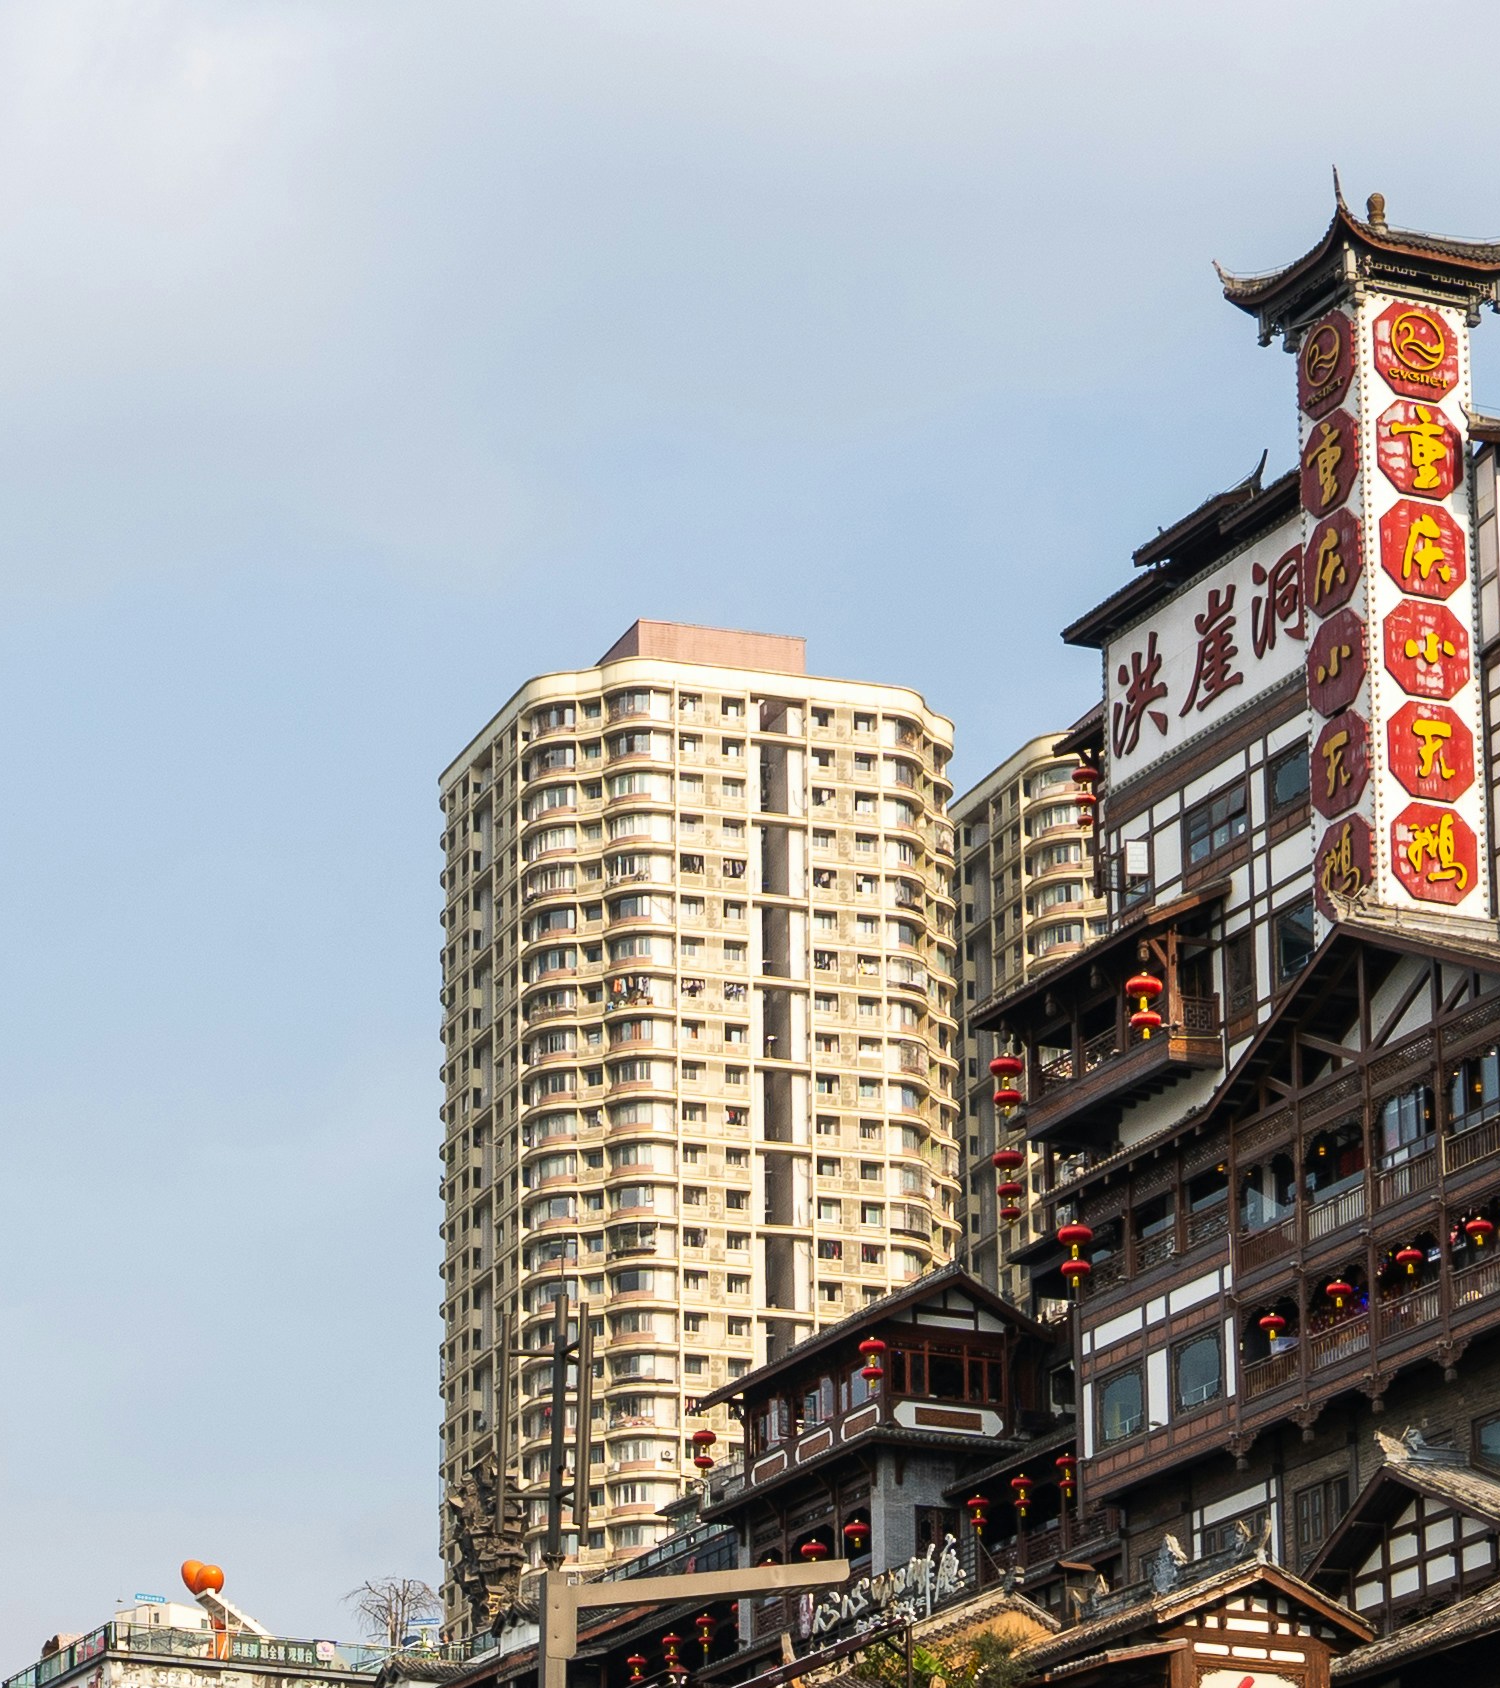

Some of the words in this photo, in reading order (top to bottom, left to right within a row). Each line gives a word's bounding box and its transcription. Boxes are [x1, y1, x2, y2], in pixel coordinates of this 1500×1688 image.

[1113, 543, 1306, 759] 洪崖洞
[1389, 405, 1467, 890] 重庆小天鹅
